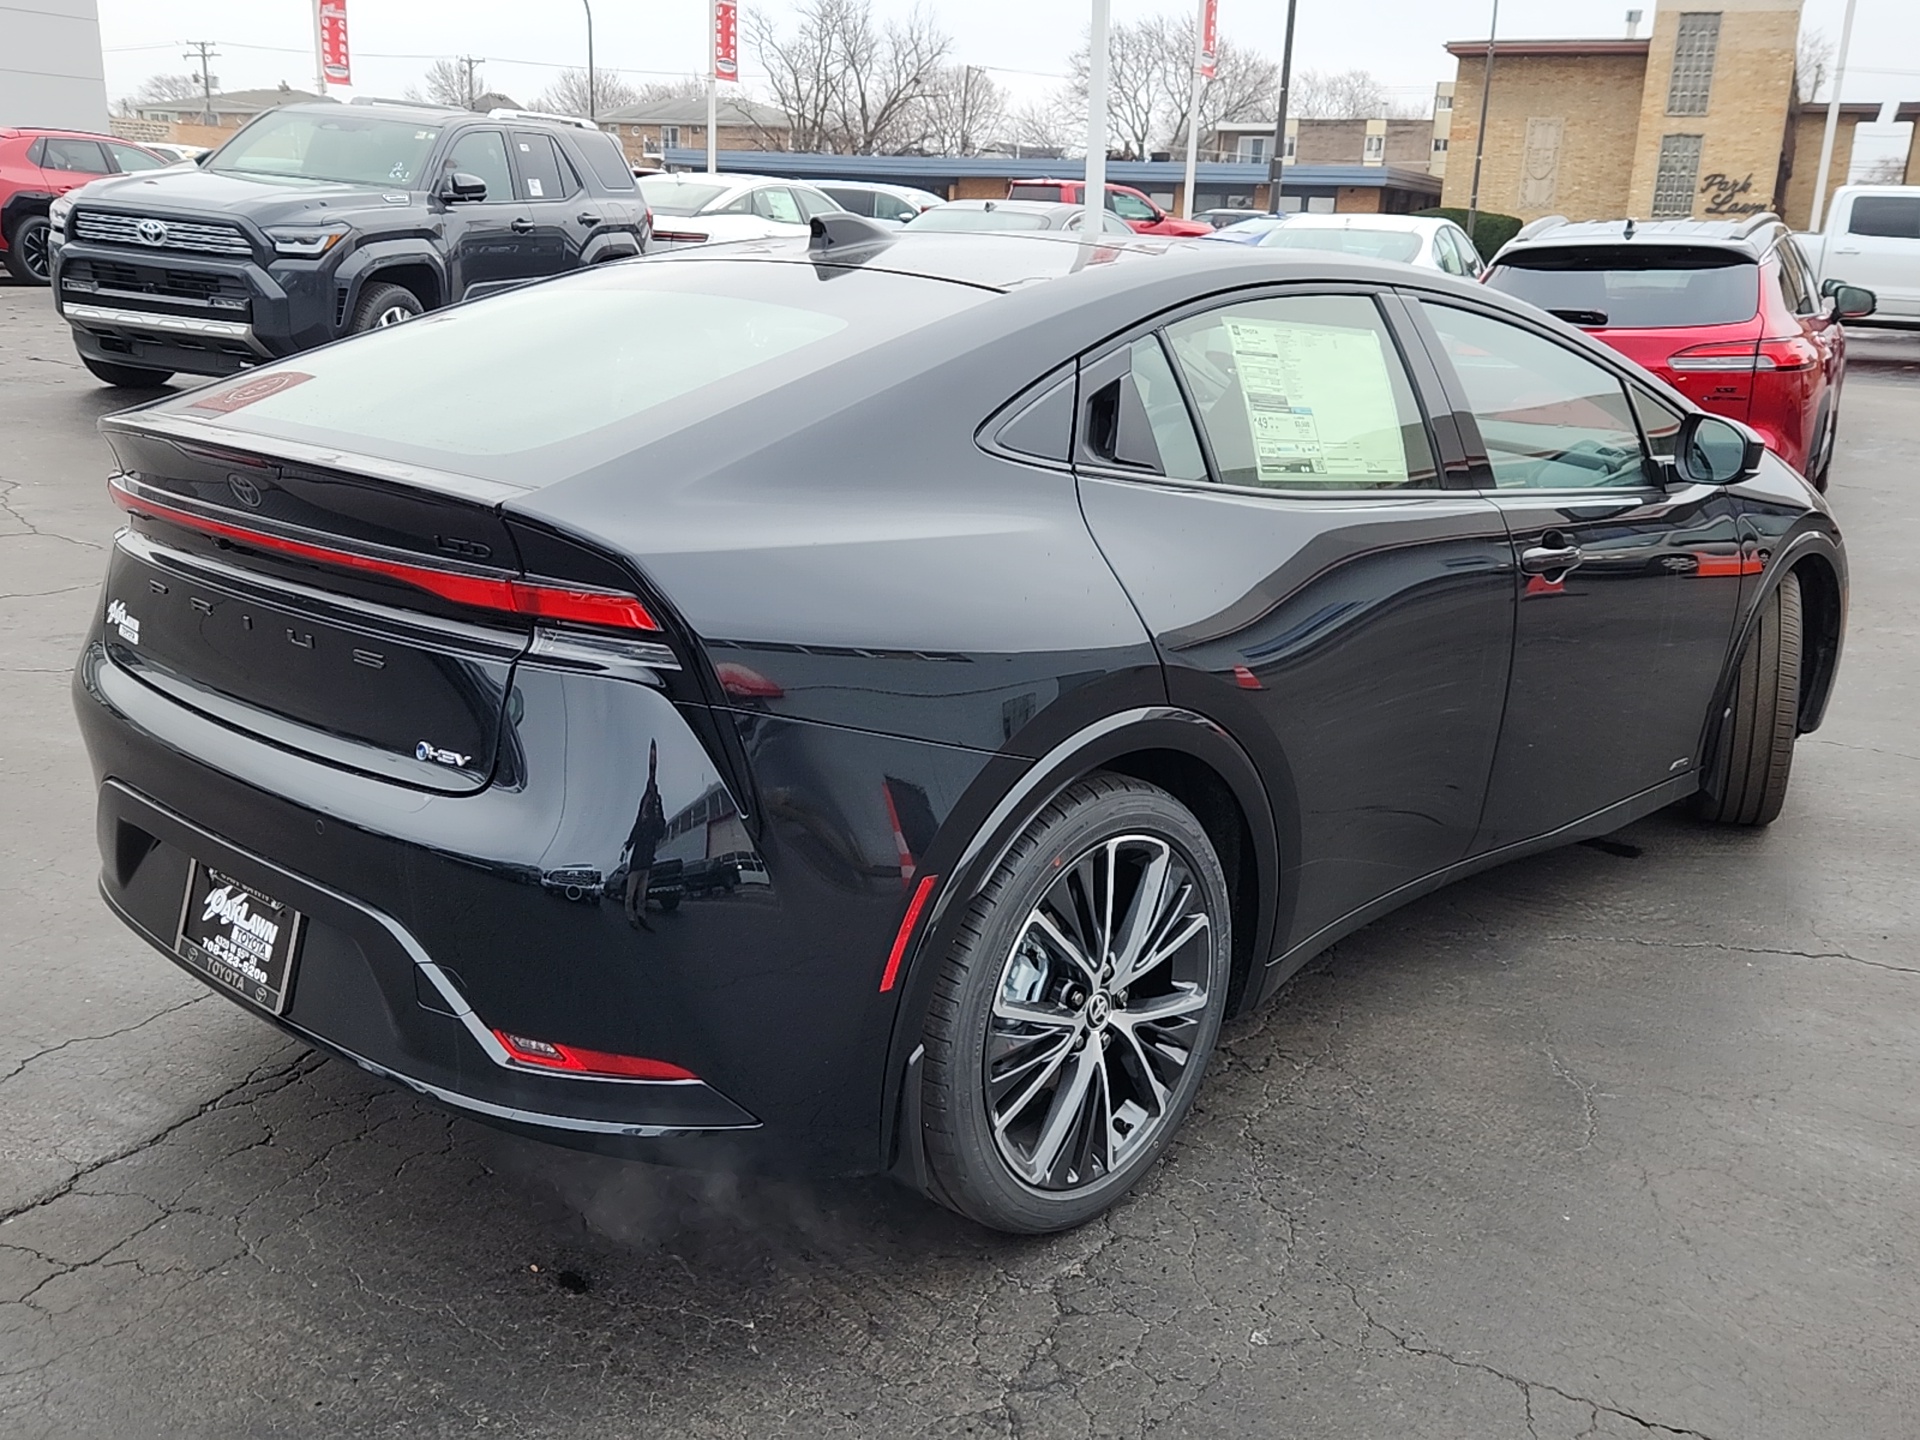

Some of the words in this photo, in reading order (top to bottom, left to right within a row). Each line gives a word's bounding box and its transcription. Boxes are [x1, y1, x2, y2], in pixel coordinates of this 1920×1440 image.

[1700, 172, 1754, 194] Park
[433, 533, 492, 559] LTD
[149, 579, 386, 670] PRIUS
[236, 928, 267, 956] TOYOTA
[202, 936, 268, 984] 708-423-5200
[206, 956, 245, 991] TOYOTA
